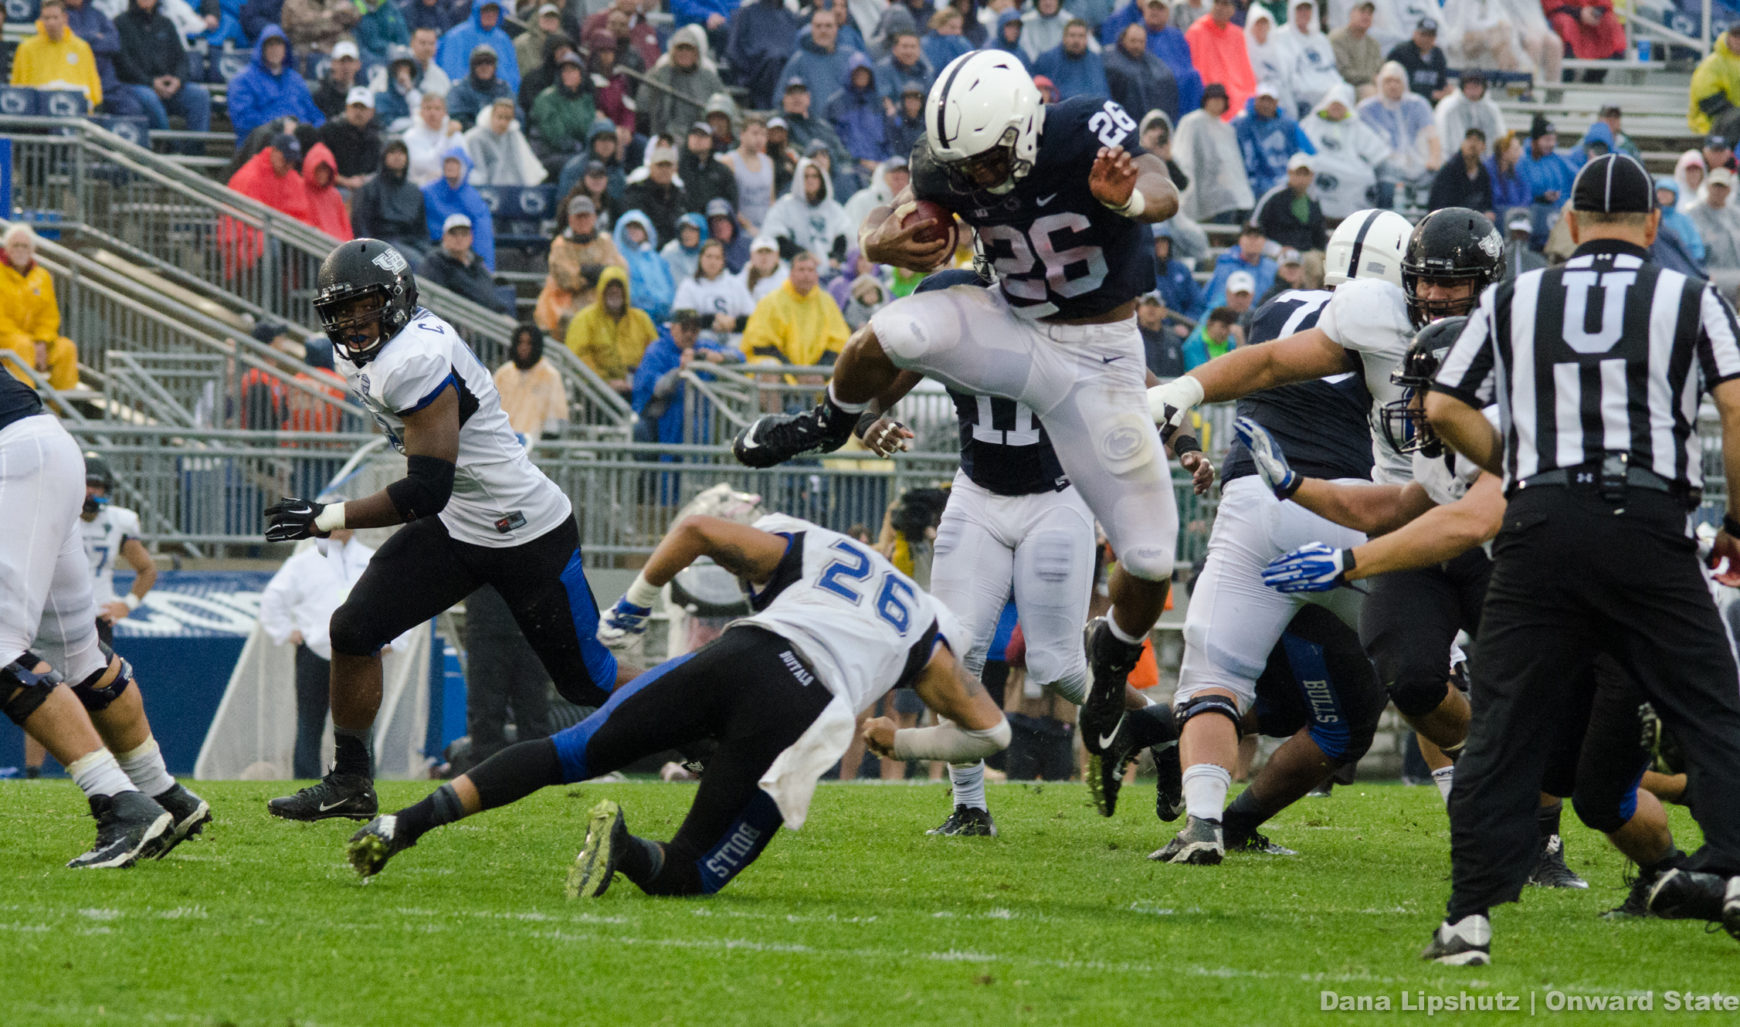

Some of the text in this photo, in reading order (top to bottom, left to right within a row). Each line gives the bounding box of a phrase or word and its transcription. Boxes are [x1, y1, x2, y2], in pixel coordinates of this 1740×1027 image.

[1088, 100, 1137, 149] 26
[371, 247, 408, 275] UB
[979, 211, 1110, 320] 26
[1561, 270, 1638, 354] U
[972, 395, 1040, 447] 11
[812, 538, 919, 637] 26
[1303, 680, 1338, 723] BULLS
[706, 822, 760, 878] BULLS
